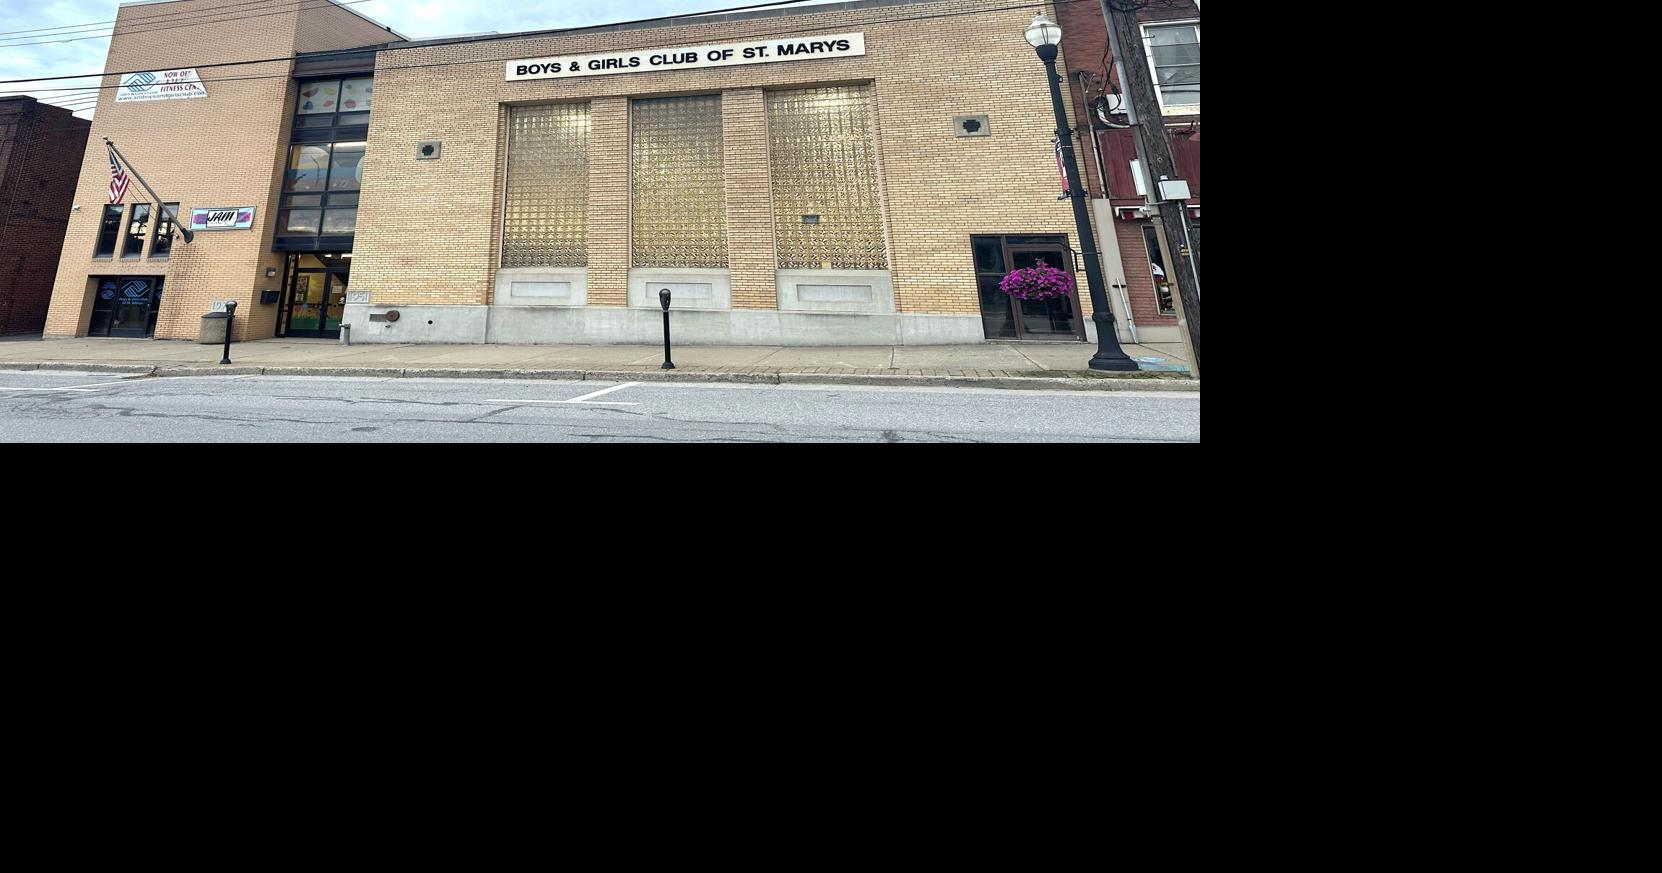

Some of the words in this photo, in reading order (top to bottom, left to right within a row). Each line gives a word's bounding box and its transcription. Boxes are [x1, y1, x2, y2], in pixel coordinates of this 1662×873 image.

[516, 62, 562, 76] BOYS
[568, 61, 581, 72] &
[587, 56, 641, 71] GIRLS
[649, 52, 699, 66] CLUB
[707, 49, 734, 62] OF
[743, 45, 769, 58] ST.
[777, 39, 851, 56] MARYS
[160, 84, 184, 92] FITNESS
[208, 211, 236, 222] JAM
